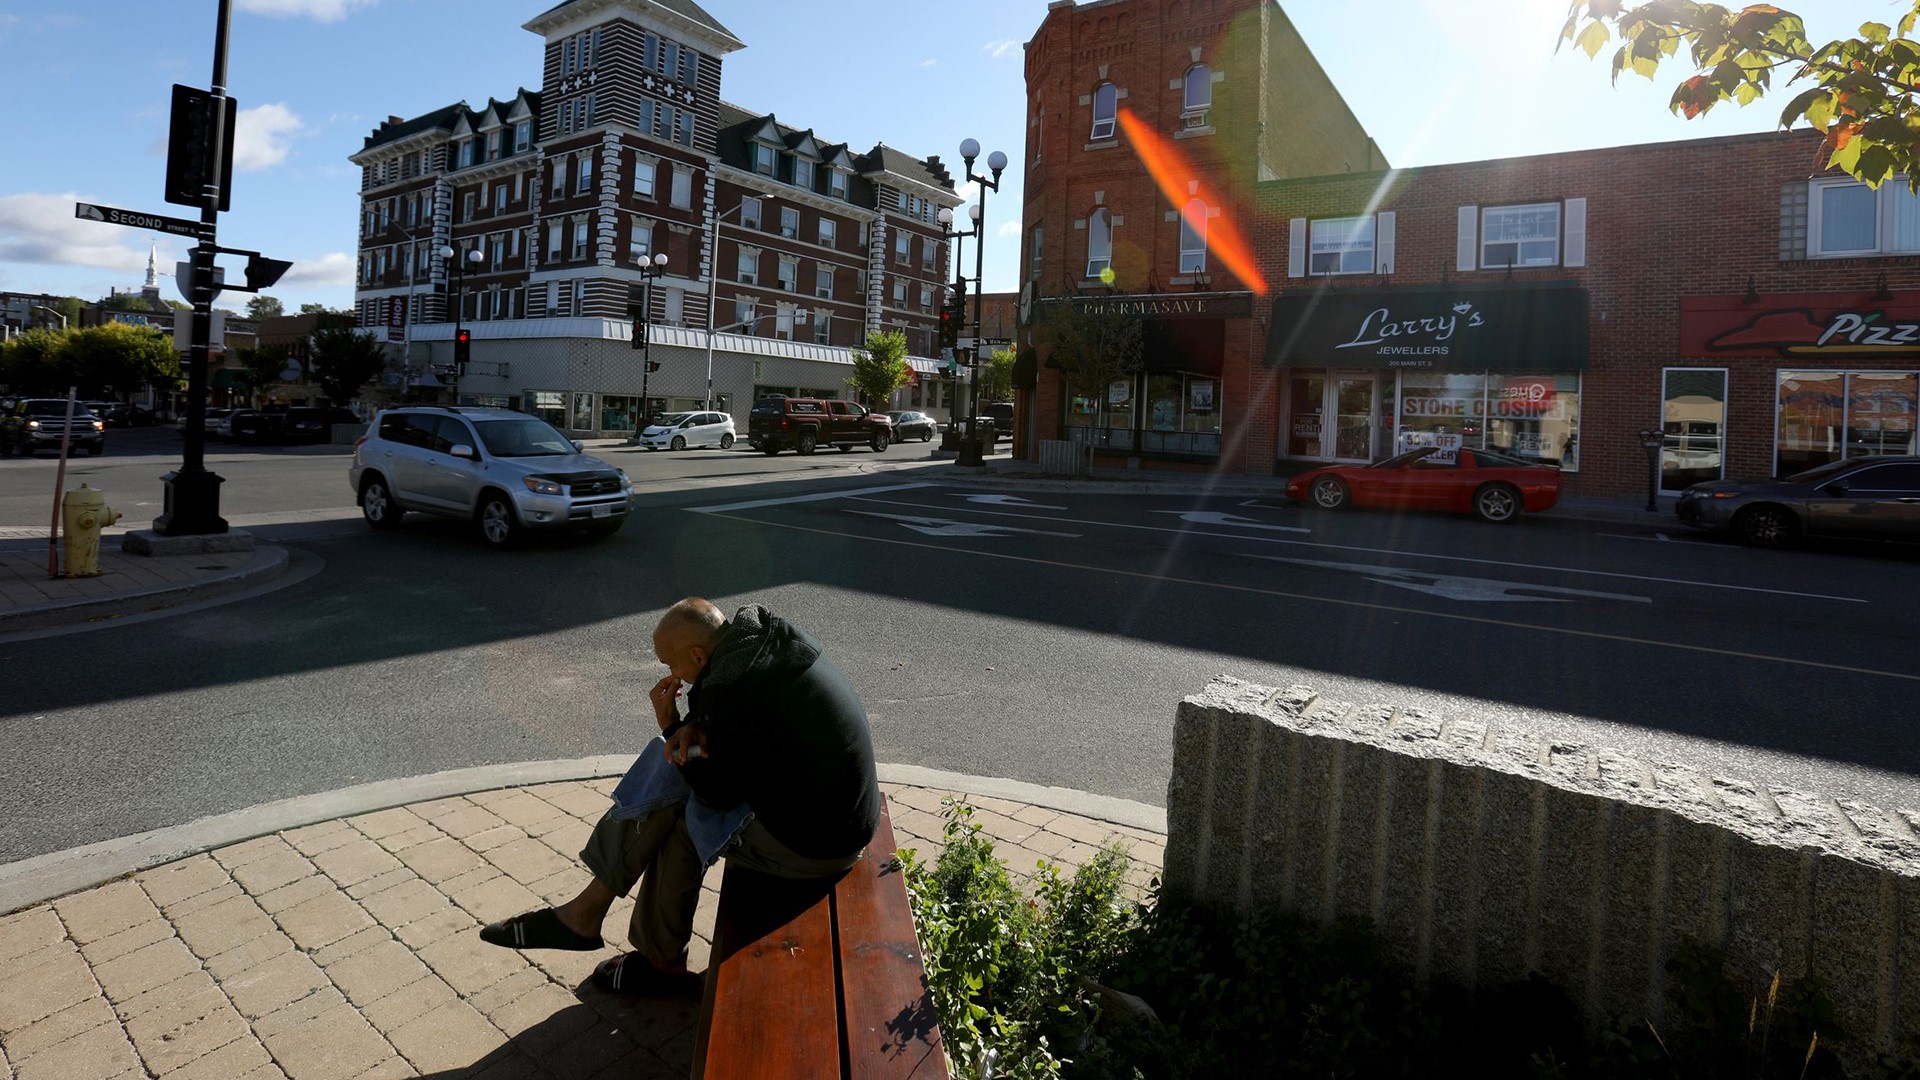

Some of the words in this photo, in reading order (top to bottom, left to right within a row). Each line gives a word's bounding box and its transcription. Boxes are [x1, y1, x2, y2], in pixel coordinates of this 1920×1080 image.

[110, 210, 162, 228] SECOND
[167, 225, 189, 233] STREET
[393, 299, 402, 326] SHOP
[1084, 300, 1207, 315] PHARMASAVE
[1335, 301, 1486, 349] Larry's
[1817, 313, 1920, 346] Pizz
[1376, 346, 1449, 355] JEWELLERS
[1405, 399, 1465, 415] STORE
[1436, 436, 1457, 447] OFF
